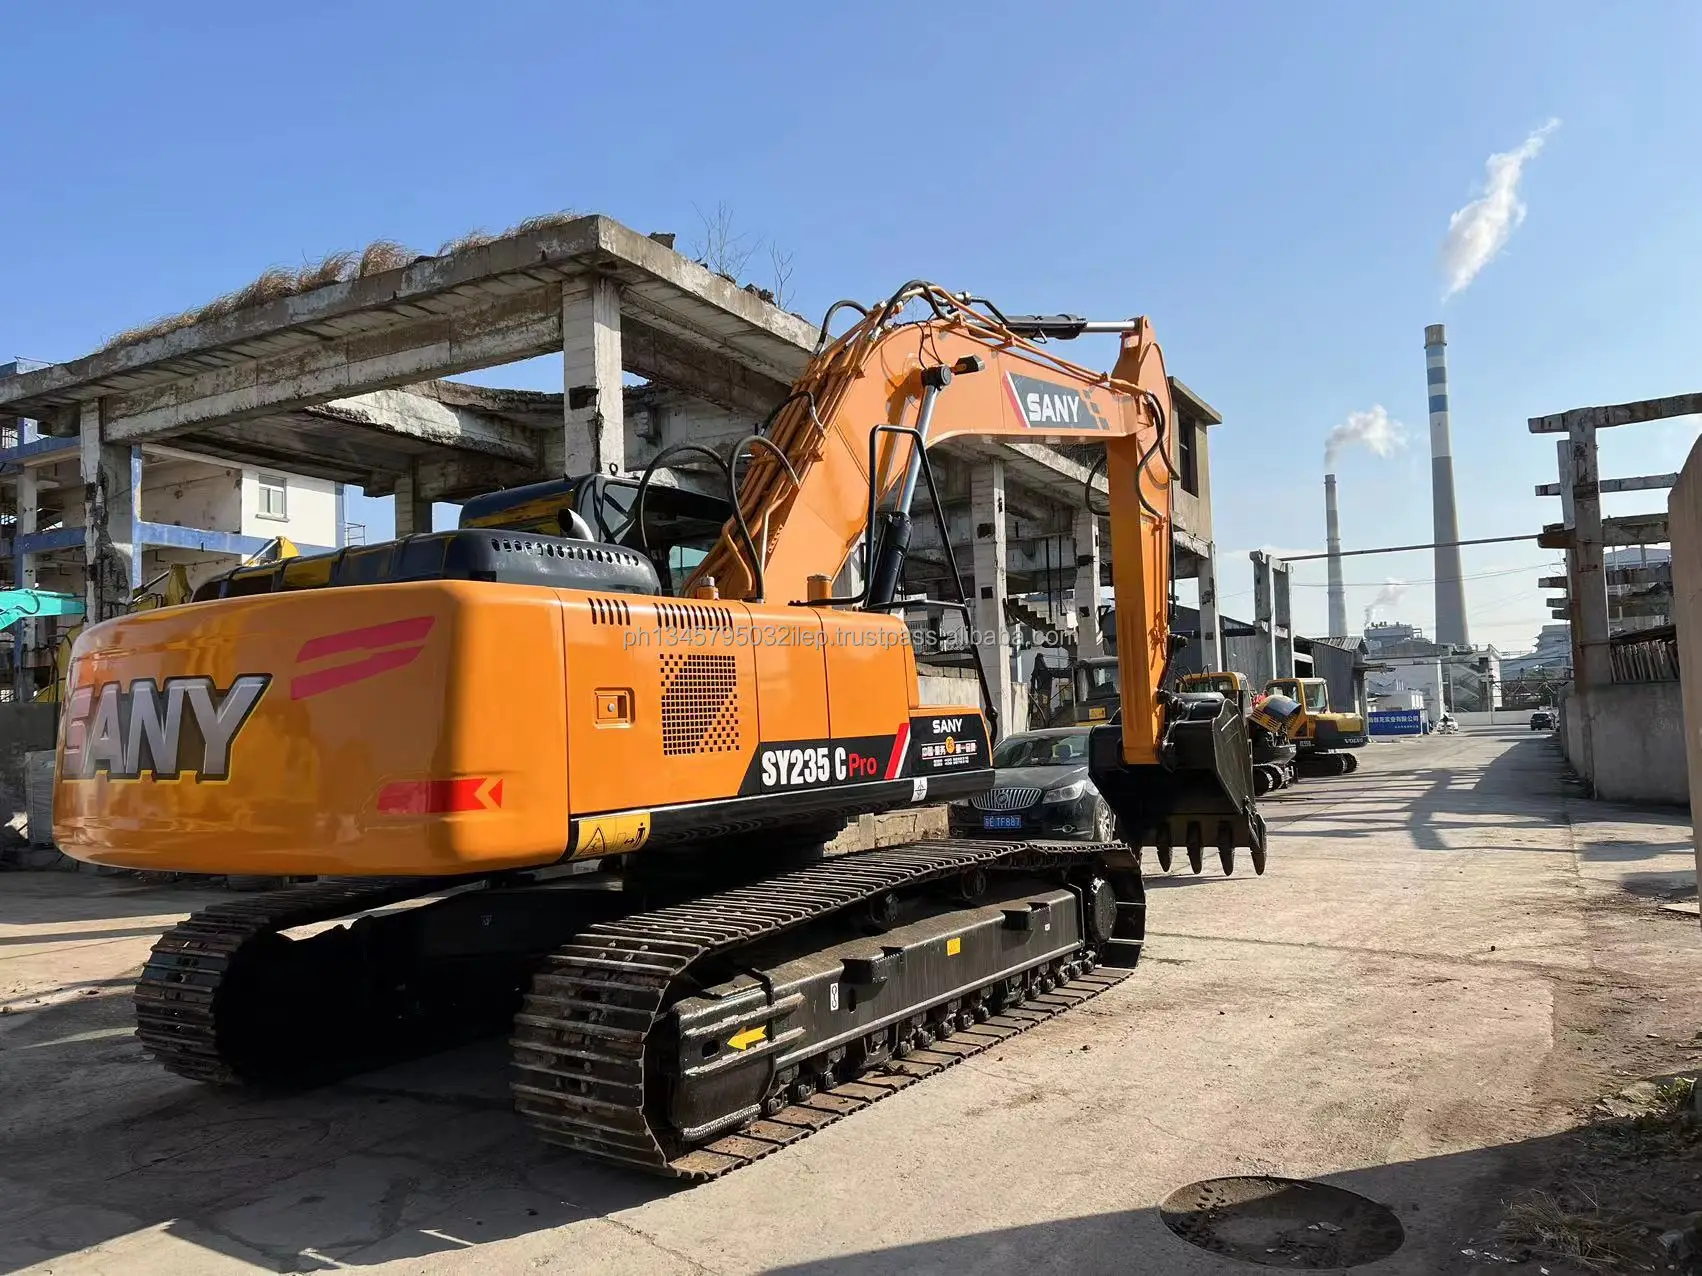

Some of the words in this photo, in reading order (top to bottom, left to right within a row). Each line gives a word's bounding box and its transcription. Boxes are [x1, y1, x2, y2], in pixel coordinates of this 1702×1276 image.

[1027, 393, 1080, 422] SANY
[932, 718, 963, 734] SANY
[849, 753, 878, 777] Pro
